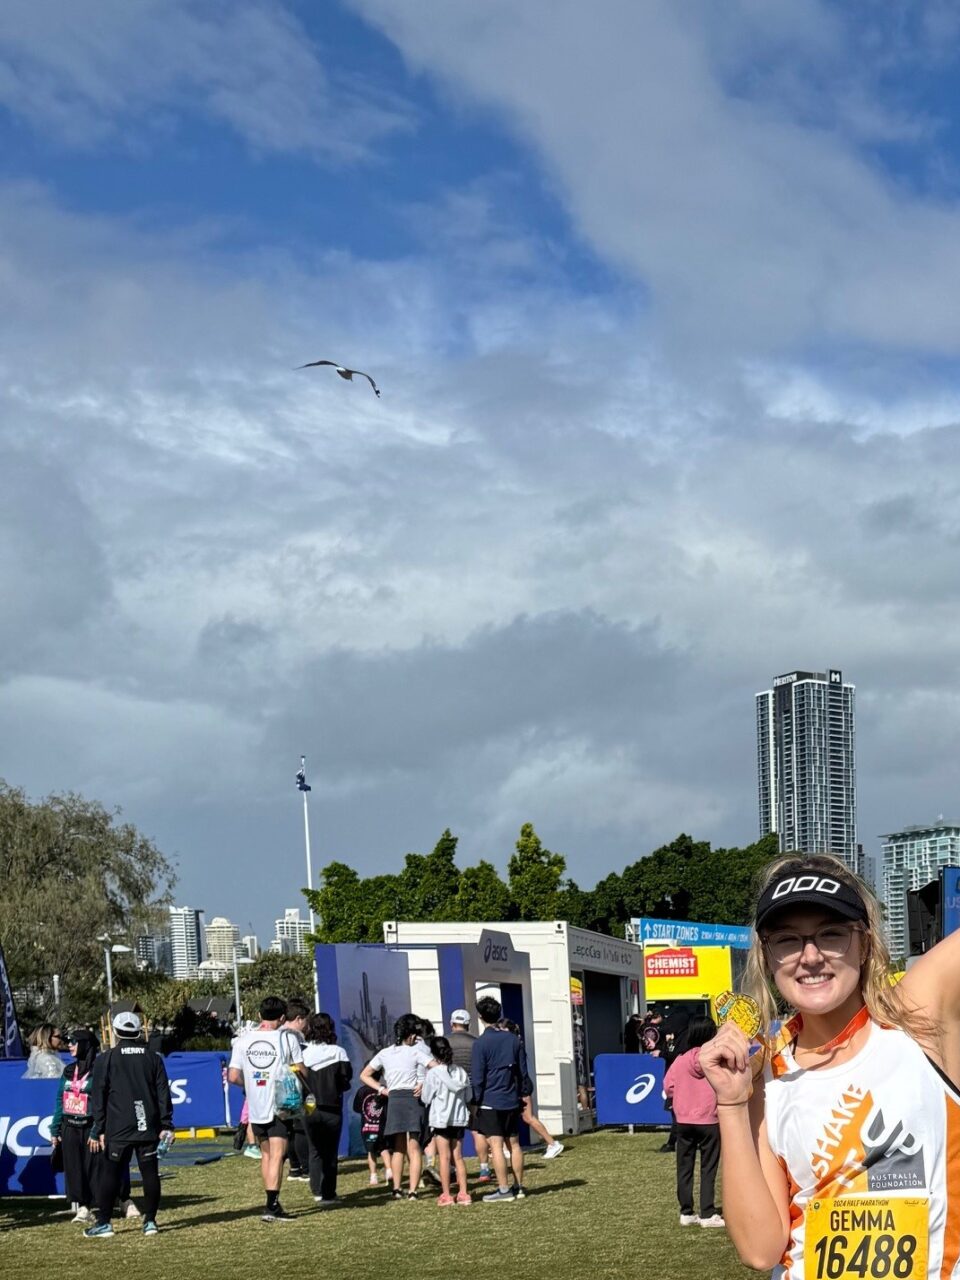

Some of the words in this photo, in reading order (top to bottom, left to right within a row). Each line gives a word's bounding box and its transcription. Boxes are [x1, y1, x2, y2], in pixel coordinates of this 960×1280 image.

[652, 923, 675, 939] START
[676, 925, 699, 941] ZONES
[647, 957, 695, 969] CHEMIST
[809, 1083, 864, 1180] SHAKE
[860, 1102, 923, 1159] UP
[871, 1172, 918, 1181] AUSTRALIA
[871, 1180, 923, 1189] FOUNDATION
[830, 1209, 896, 1232] GEMMA
[814, 1234, 917, 1280] 16488
